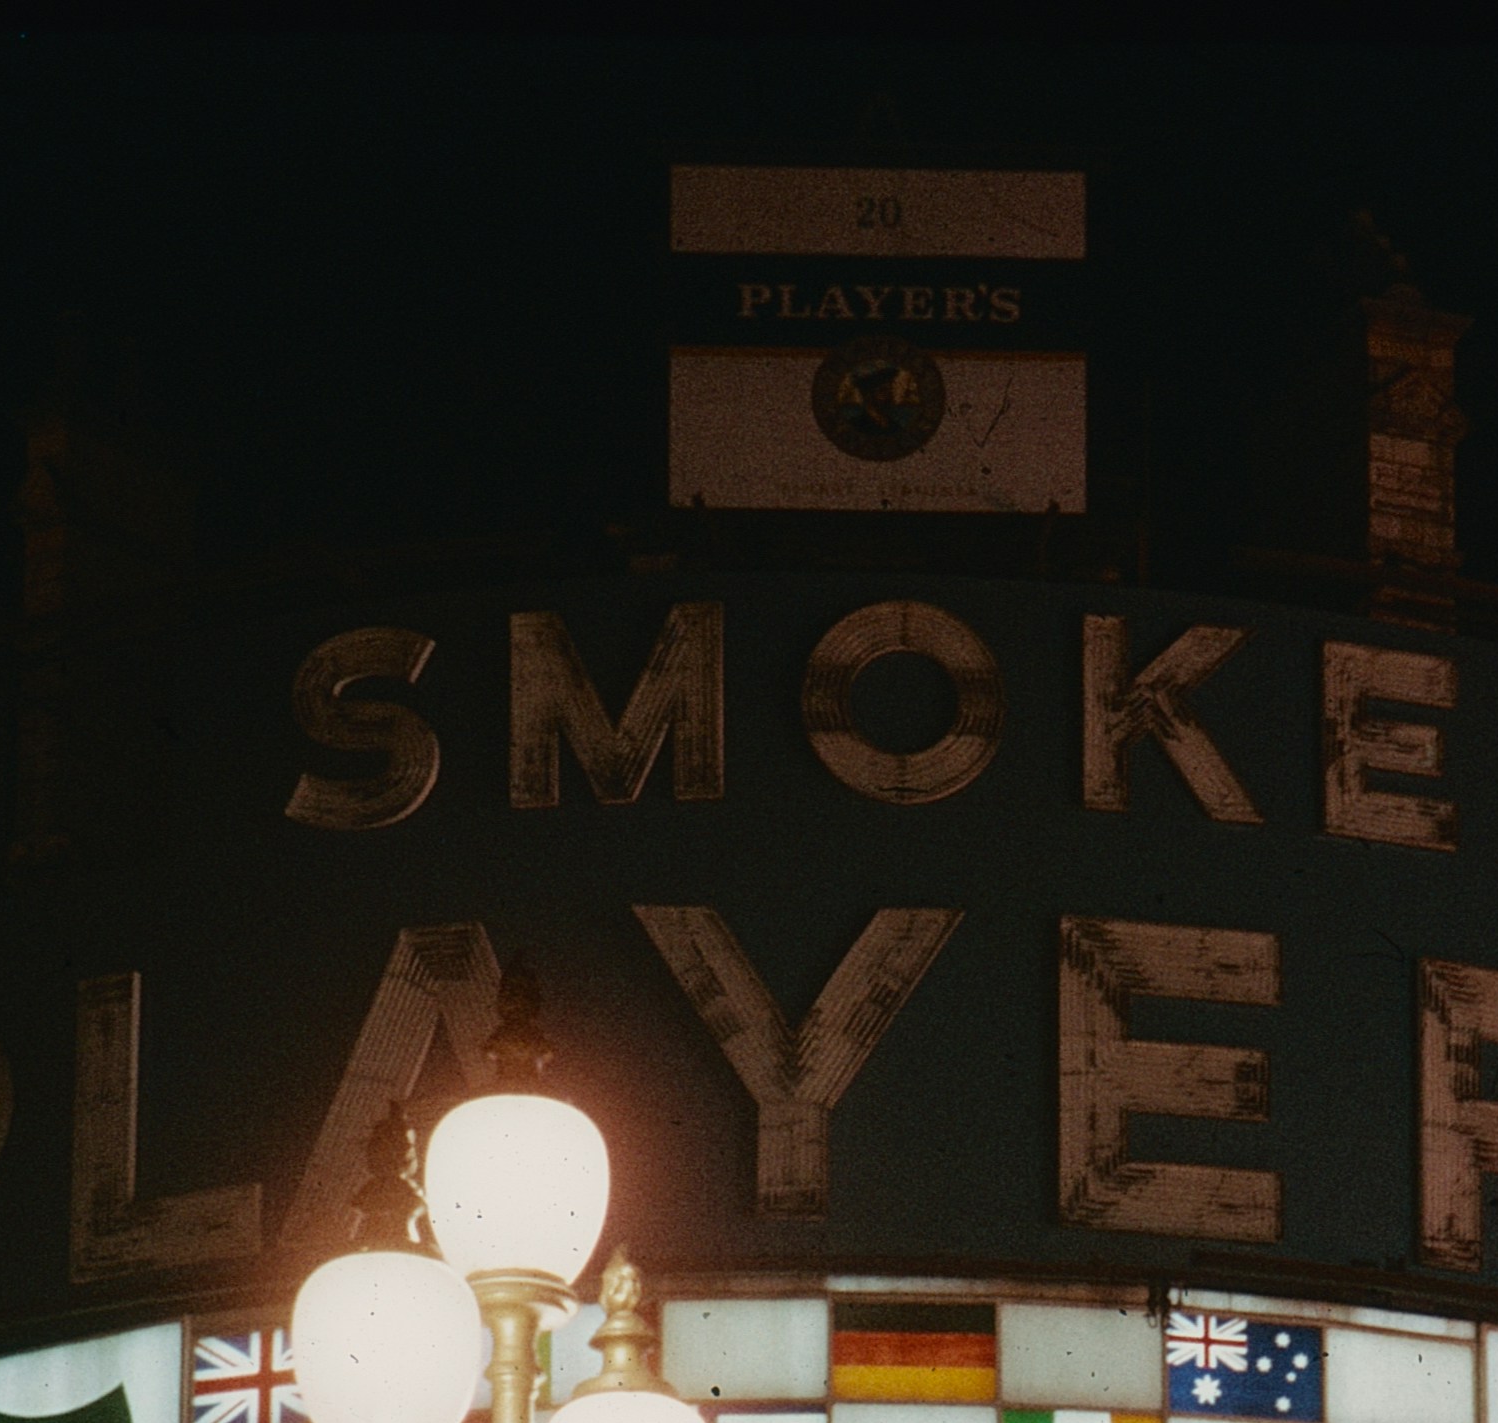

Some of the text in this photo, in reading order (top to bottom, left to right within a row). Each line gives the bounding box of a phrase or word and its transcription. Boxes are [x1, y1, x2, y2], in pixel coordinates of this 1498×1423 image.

[854, 196, 902, 231] 20
[736, 281, 1023, 323] PLAYER'S
[284, 598, 1462, 855] SMOKE
